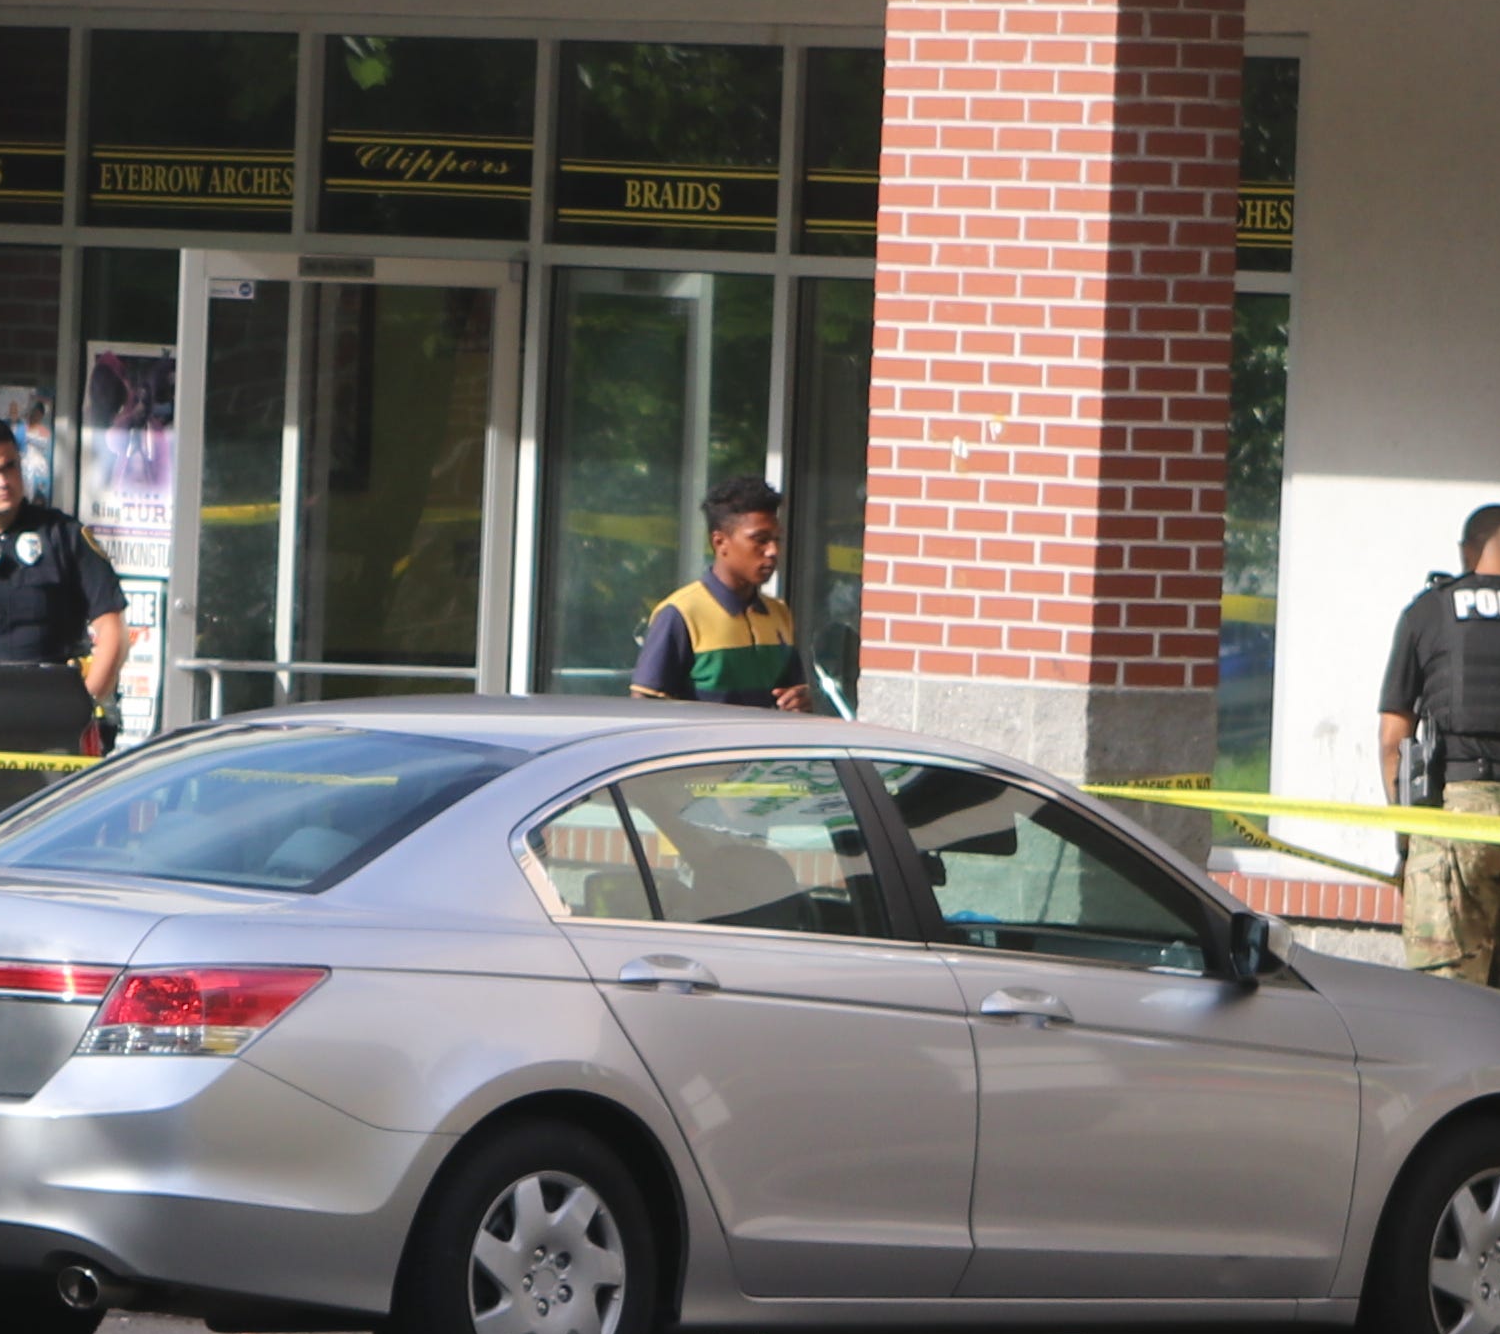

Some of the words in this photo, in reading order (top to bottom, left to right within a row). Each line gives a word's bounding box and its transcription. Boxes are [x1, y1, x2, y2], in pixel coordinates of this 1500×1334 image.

[100, 163, 203, 194] EYEBROW
[208, 166, 294, 196] ARCHES
[355, 144, 510, 182] Clippers
[625, 179, 722, 212] BRAIDS
